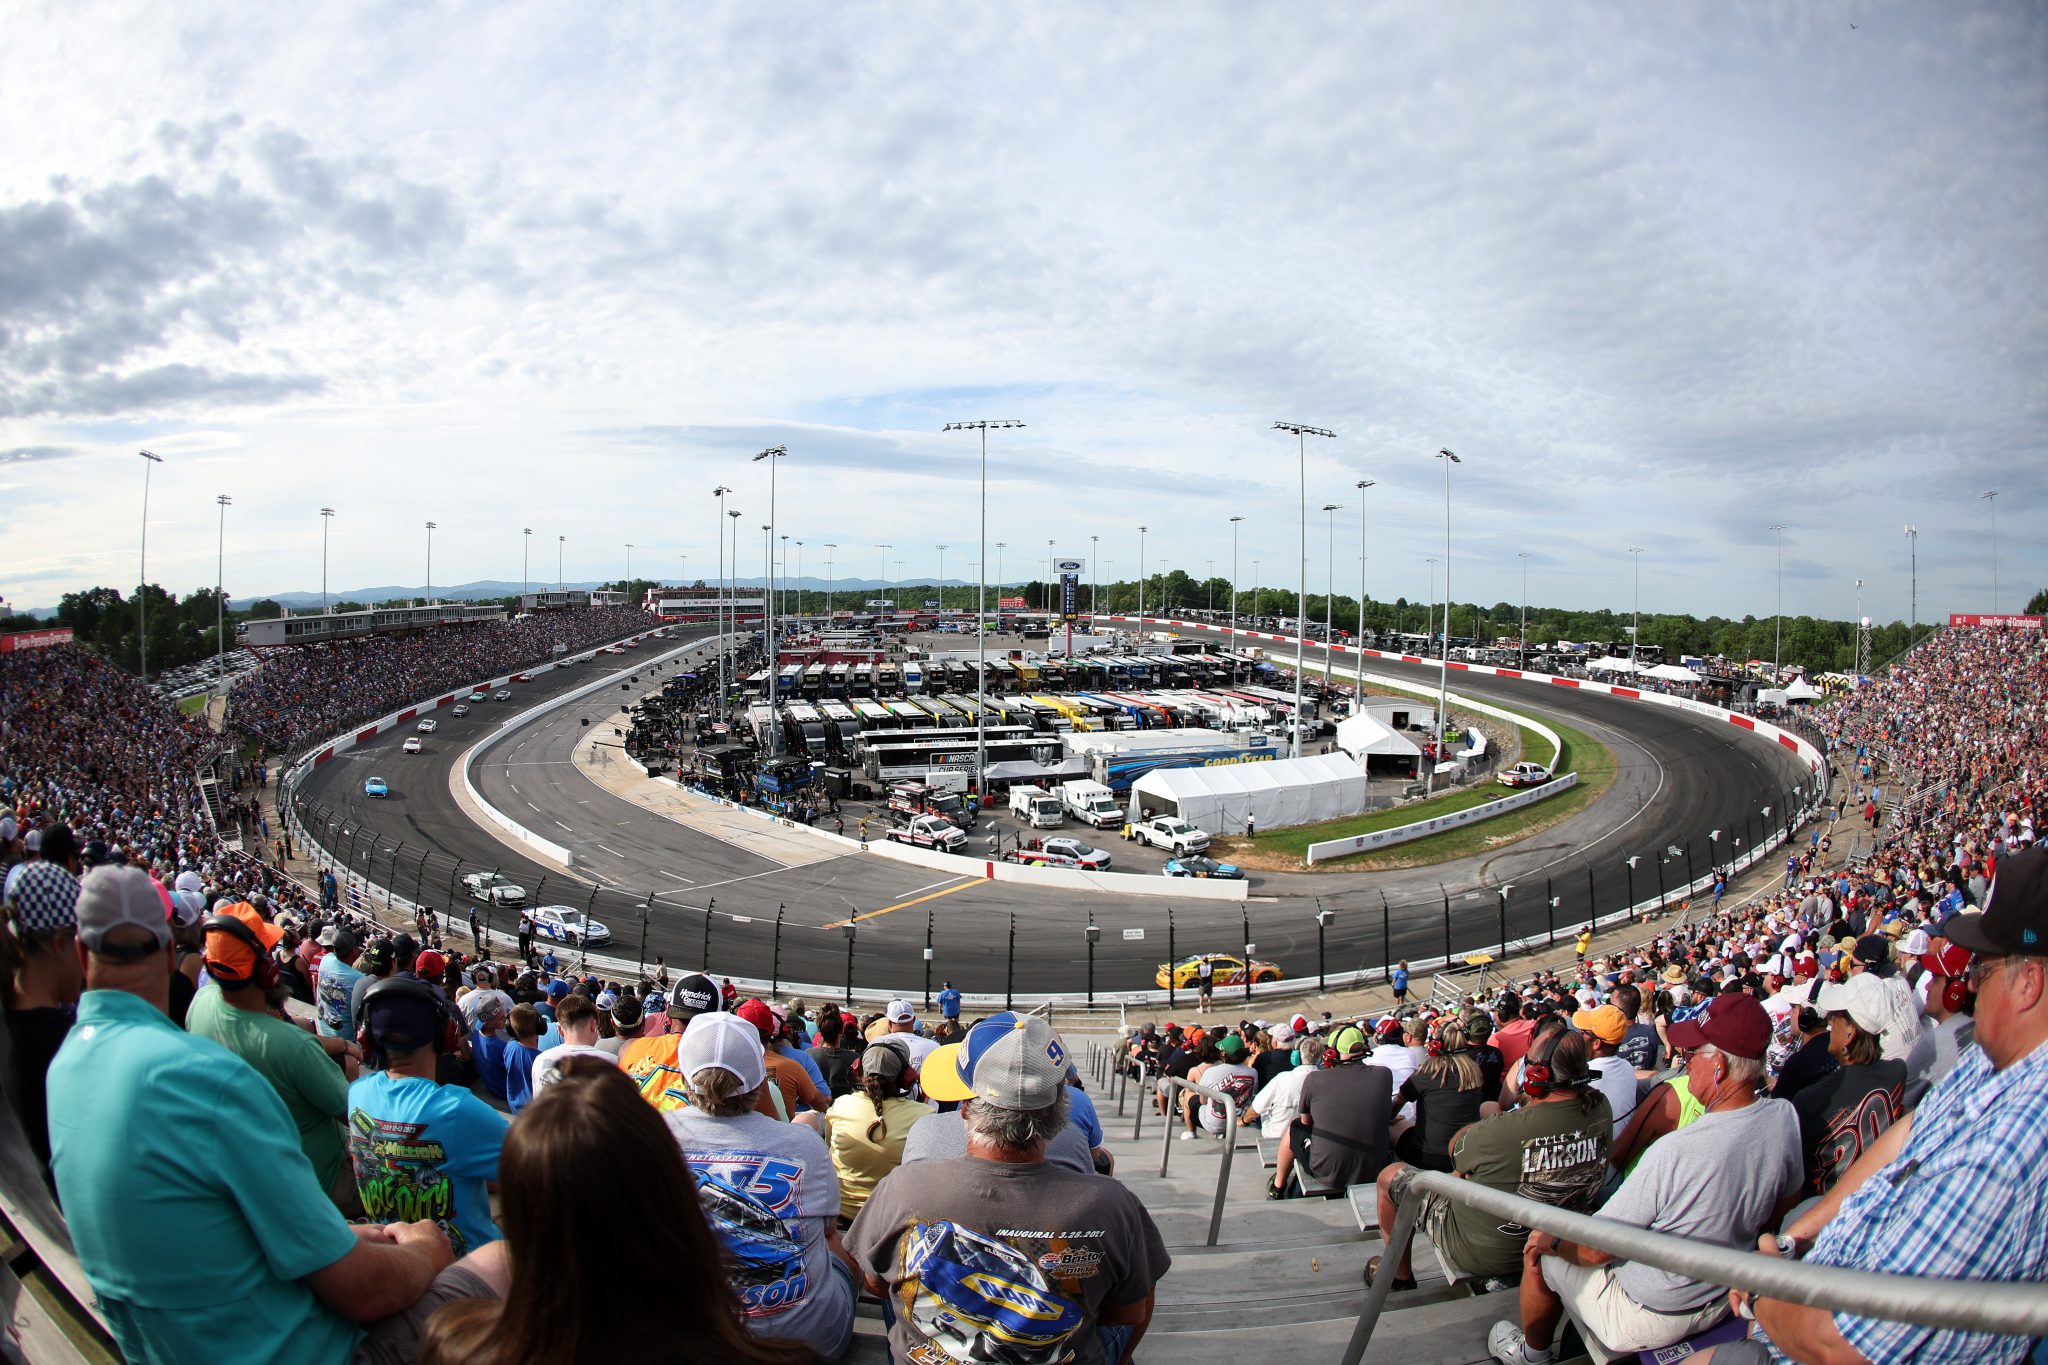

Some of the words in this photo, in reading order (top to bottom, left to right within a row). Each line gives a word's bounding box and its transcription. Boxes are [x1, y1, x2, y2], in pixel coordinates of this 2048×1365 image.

[948, 754, 976, 763] NASCA
[1204, 753, 1273, 768] GOODYEAR
[680, 988, 712, 1001] Hendrick
[1046, 1040, 1065, 1068] 9
[1535, 1133, 1566, 1147] KYLE
[385, 1140, 443, 1159] MILLION
[1523, 1136, 1598, 1173] LARSON
[688, 1154, 757, 1162] MOTORSPORTS
[744, 1158, 806, 1211] 5
[995, 1229, 1056, 1239] INAUGURAL
[1058, 1230, 1106, 1239] 3.28.2021
[1061, 1250, 1105, 1264] Bristol
[742, 1272, 810, 1312] son
[978, 1279, 1057, 1313] NAPA
[1656, 1344, 1691, 1361] DICK'S
